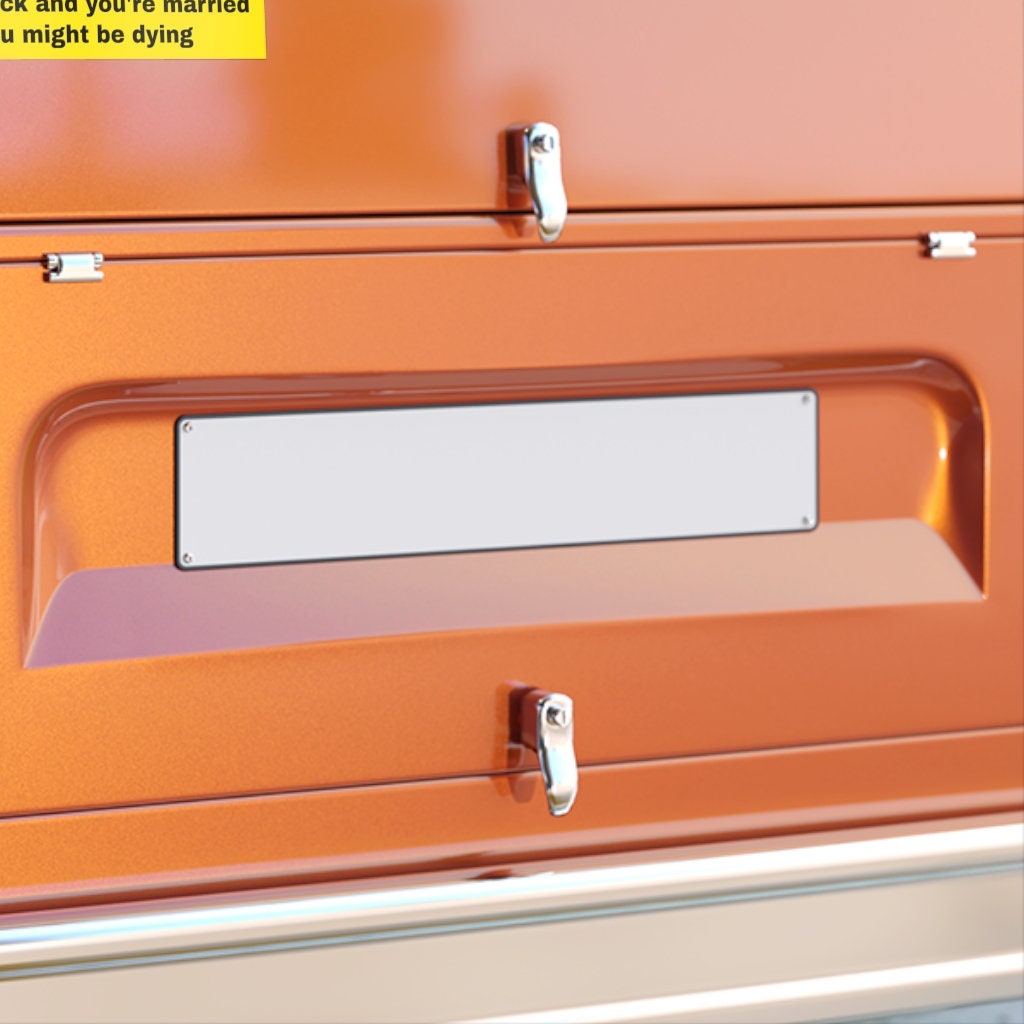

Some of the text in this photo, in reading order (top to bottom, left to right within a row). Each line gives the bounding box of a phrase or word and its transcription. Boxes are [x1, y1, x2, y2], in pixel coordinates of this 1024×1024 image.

[22, 24, 90, 49] might
[97, 24, 125, 44] be
[132, 24, 194, 49] dying
